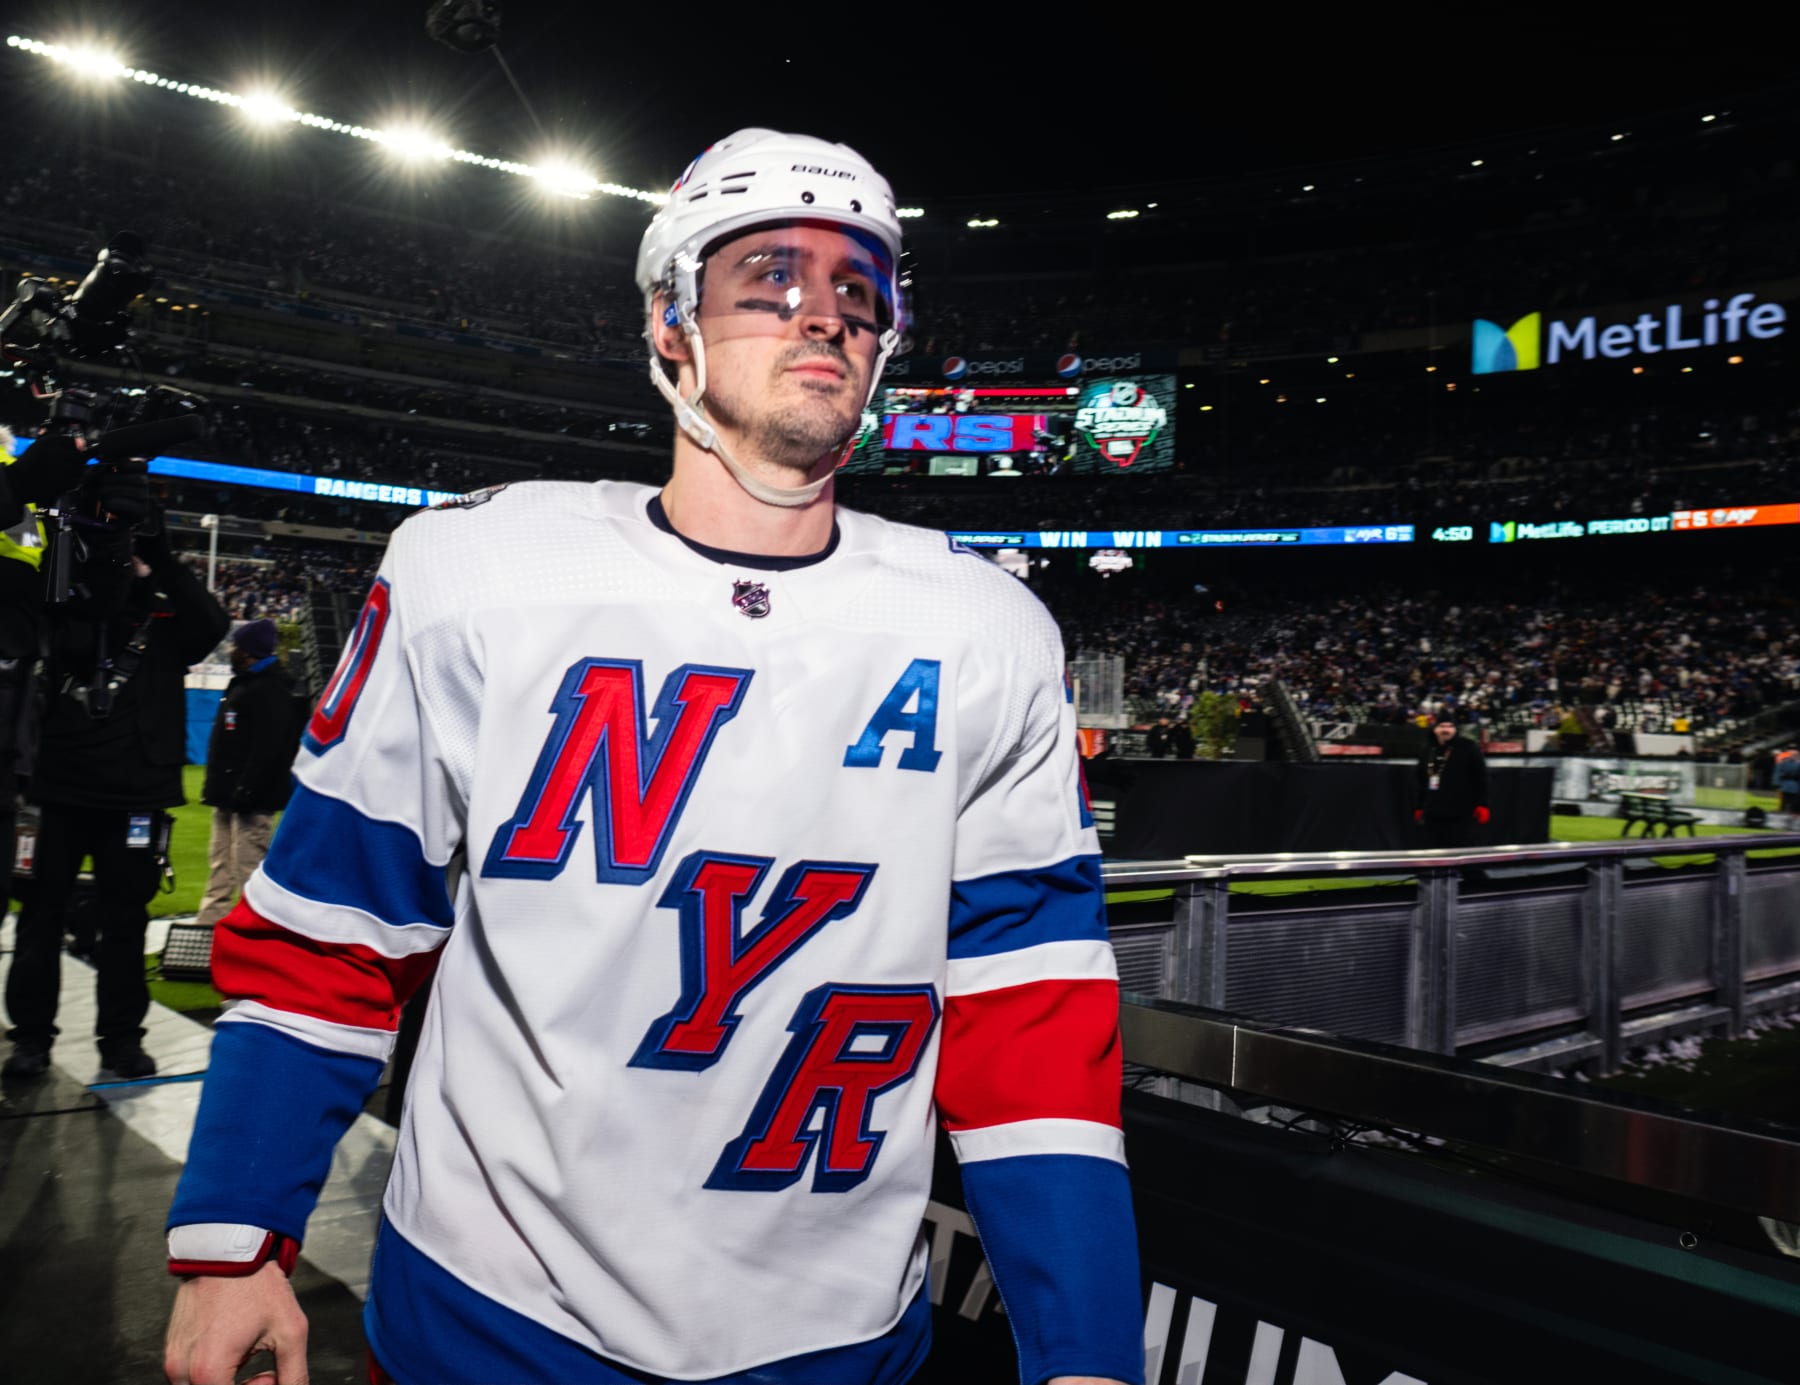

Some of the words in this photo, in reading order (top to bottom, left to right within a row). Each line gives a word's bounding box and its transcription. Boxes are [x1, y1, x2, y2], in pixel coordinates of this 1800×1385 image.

[1546, 293, 1787, 364] MetLife
[966, 357, 1024, 377] pepsi
[1082, 352, 1141, 373] pepsi
[314, 477, 422, 506] RANGERS
[1039, 531, 1087, 547] WIN
[1112, 531, 1162, 547] WIN
[1432, 526, 1473, 541] 4:50
[1517, 521, 1584, 539] MetLife
[1588, 518, 1649, 534] PERIOD
[843, 658, 943, 772] A
